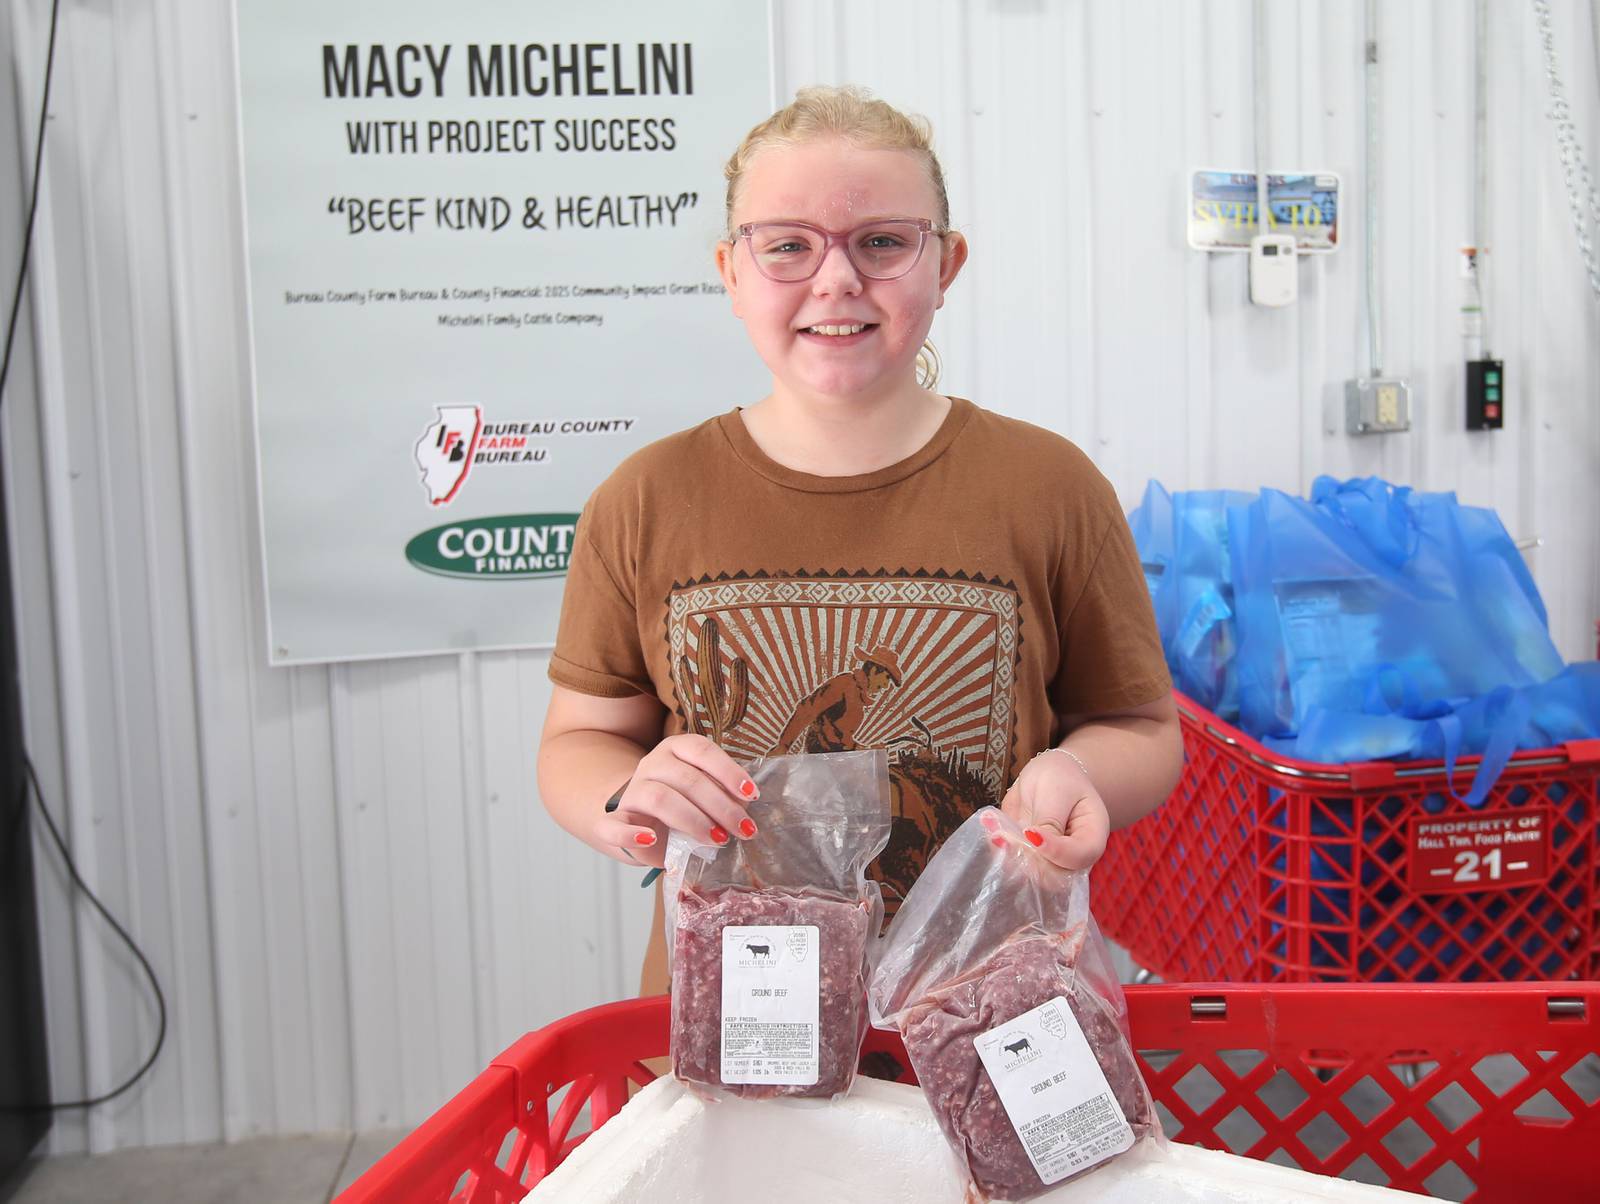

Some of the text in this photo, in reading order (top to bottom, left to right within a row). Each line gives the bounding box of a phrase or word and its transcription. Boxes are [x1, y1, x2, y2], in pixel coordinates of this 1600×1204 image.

[322, 42, 694, 98] MACY MICHELINI
[346, 118, 676, 154] WITH PROJECT SUCCESS
[327, 192, 698, 234] “BEEF KIND & HEALTHY”
[285, 290, 324, 304] Bureau
[326, 289, 366, 305] County
[368, 289, 396, 301] Farm
[400, 288, 438, 301] Bureau
[441, 287, 449, 299] &
[452, 287, 491, 302] County
[545, 285, 570, 298] 2025
[572, 284, 630, 299] Community
[632, 284, 667, 297] Impact
[669, 283, 699, 295] Grant
[701, 283, 727, 296] Recip
[438, 312, 603, 328] Michelini Family Cattle Company
[483, 420, 634, 436] BUREAU COUNTY
[478, 437, 527, 449] FARM
[475, 451, 546, 464] BUREAU
[437, 525, 576, 559] COUNT
[475, 553, 571, 572] FINANCI
[1418, 816, 1541, 835] PROPERTY OF
[752, 988, 788, 996] GROUND BEEF
[1004, 1047, 1042, 1071] MICHELINI
[1030, 1070, 1068, 1095] GROUND BEEF
[1018, 1112, 1051, 1131] KEEP FROZEN
[1027, 1126, 1040, 1135] SAFE
[1065, 1094, 1103, 1116] INSTRUCTIONS
